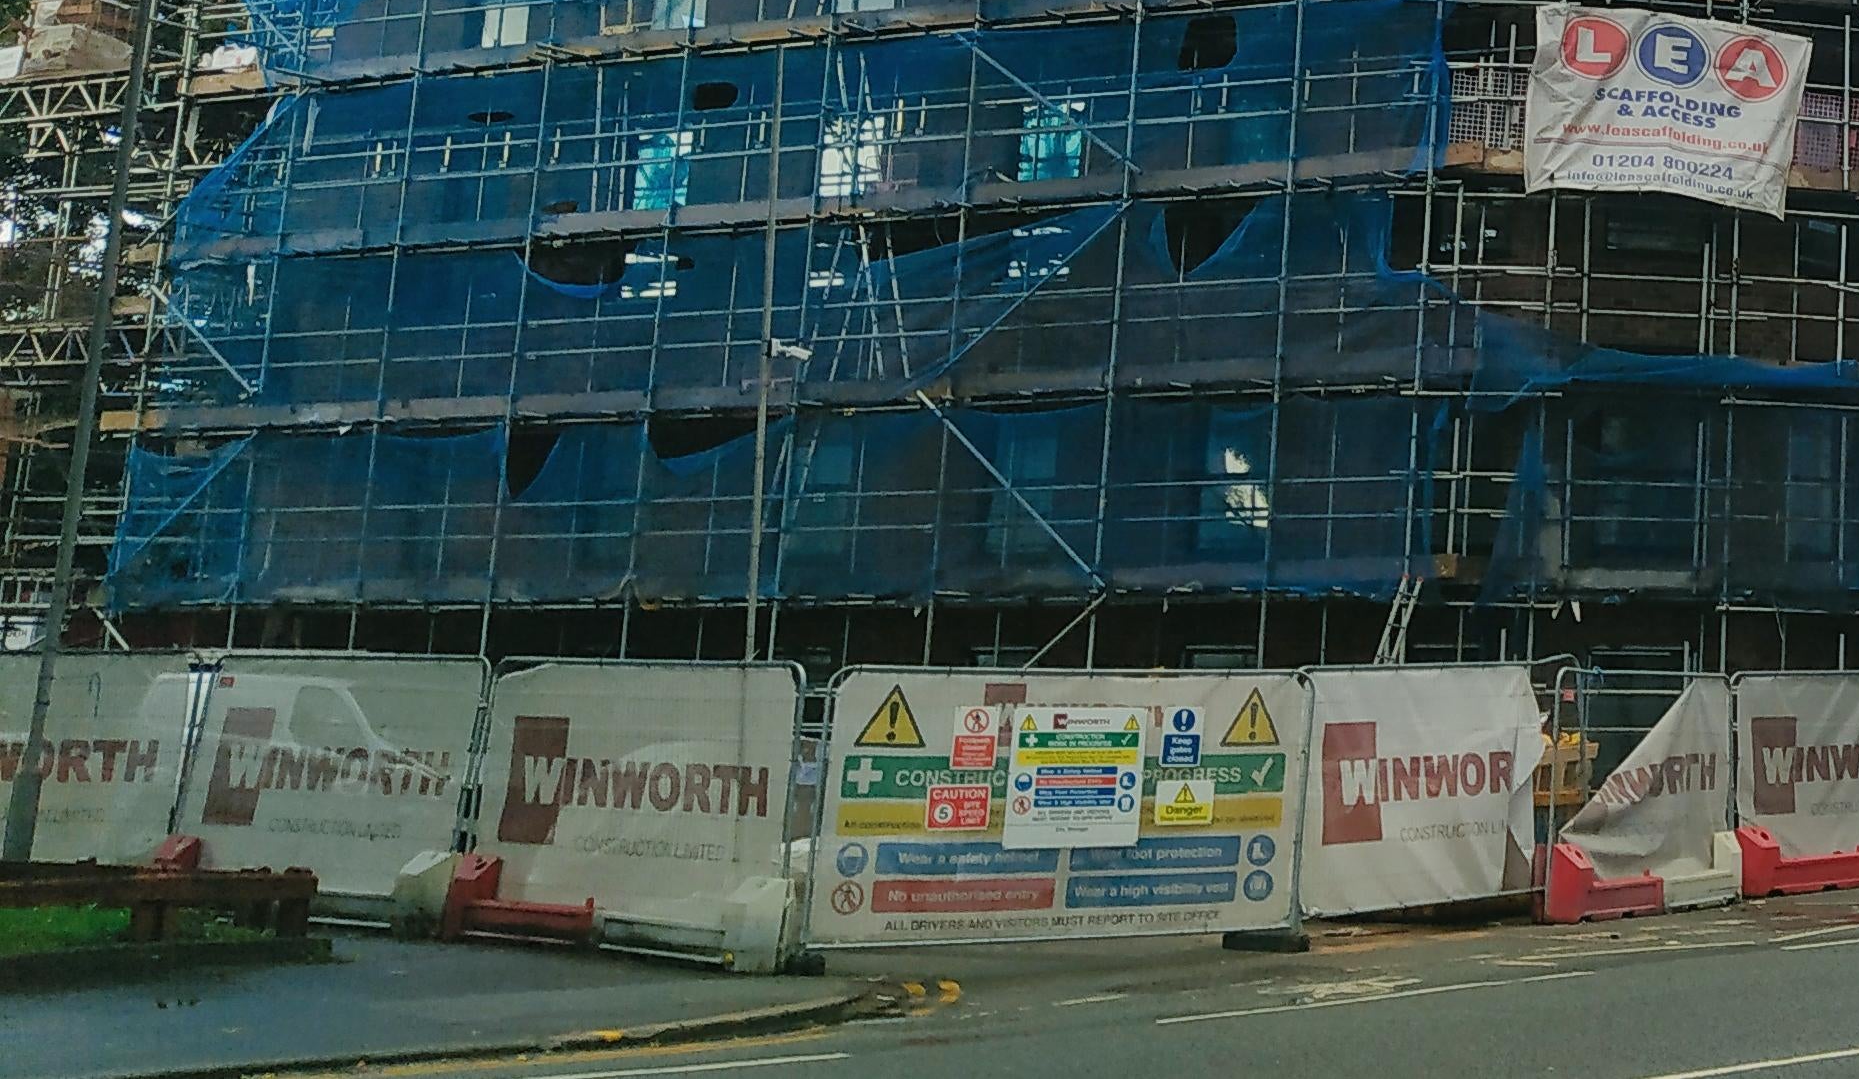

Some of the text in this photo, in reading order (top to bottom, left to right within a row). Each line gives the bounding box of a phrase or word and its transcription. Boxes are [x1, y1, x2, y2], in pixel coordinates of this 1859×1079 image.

[1576, 25, 1777, 89] LEA
[1594, 87, 1742, 118] SCAFFOLDING
[1617, 103, 1717, 129] & ACCESS
[1563, 123, 1770, 155] www.leascaffolding.co.uk
[1592, 153, 1734, 181] 01204 800224
[524, 754, 770, 818] WINWORTH
[932, 788, 987, 801] CAUTION
[938, 806, 949, 820] 5
[1165, 804, 1204, 816] Danger
[1156, 846, 1223, 861] protection
[887, 890, 907, 902] No
[1120, 883, 1149, 899] high
[1151, 882, 1203, 896] visibility
[883, 920, 907, 931] ALL
[910, 920, 965, 931] DRIVERS
[969, 919, 993, 930] AND
[1051, 914, 1084, 926] MUST
[1086, 913, 1135, 926] REPORT
[1137, 912, 1155, 924] TO
[1156, 910, 1182, 923] SITE
[1184, 909, 1222, 921] OFFICE
